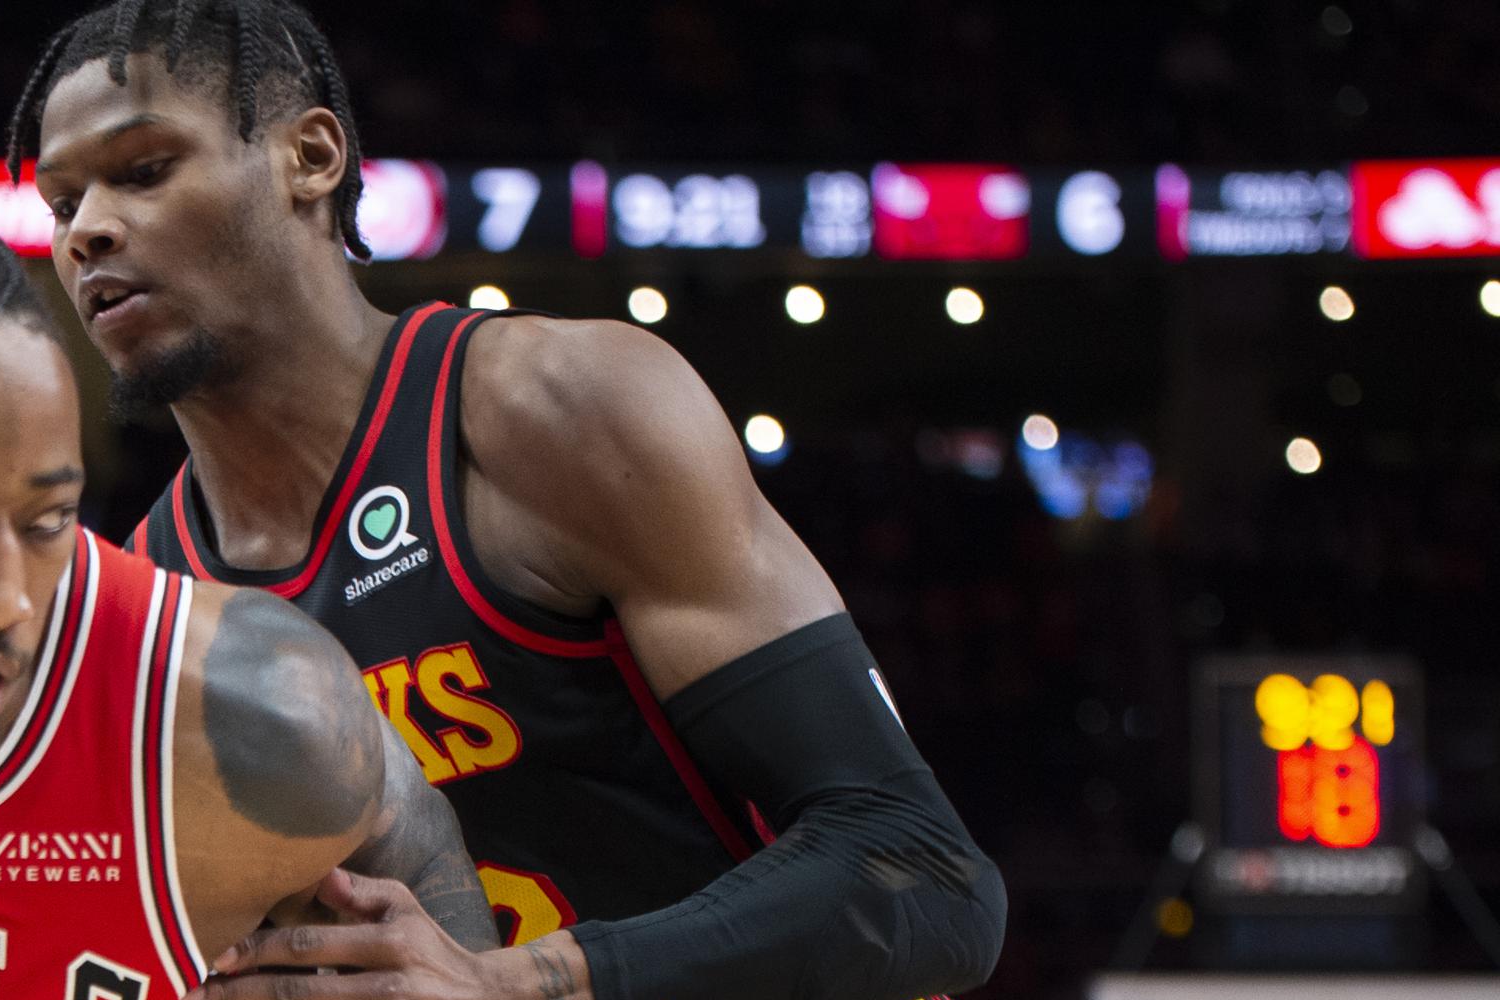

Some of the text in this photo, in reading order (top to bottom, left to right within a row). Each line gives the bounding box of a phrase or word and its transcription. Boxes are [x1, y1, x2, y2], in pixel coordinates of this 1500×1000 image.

[472, 167, 541, 252] 7
[1056, 170, 1125, 256] 6
[344, 547, 430, 602] sharecare
